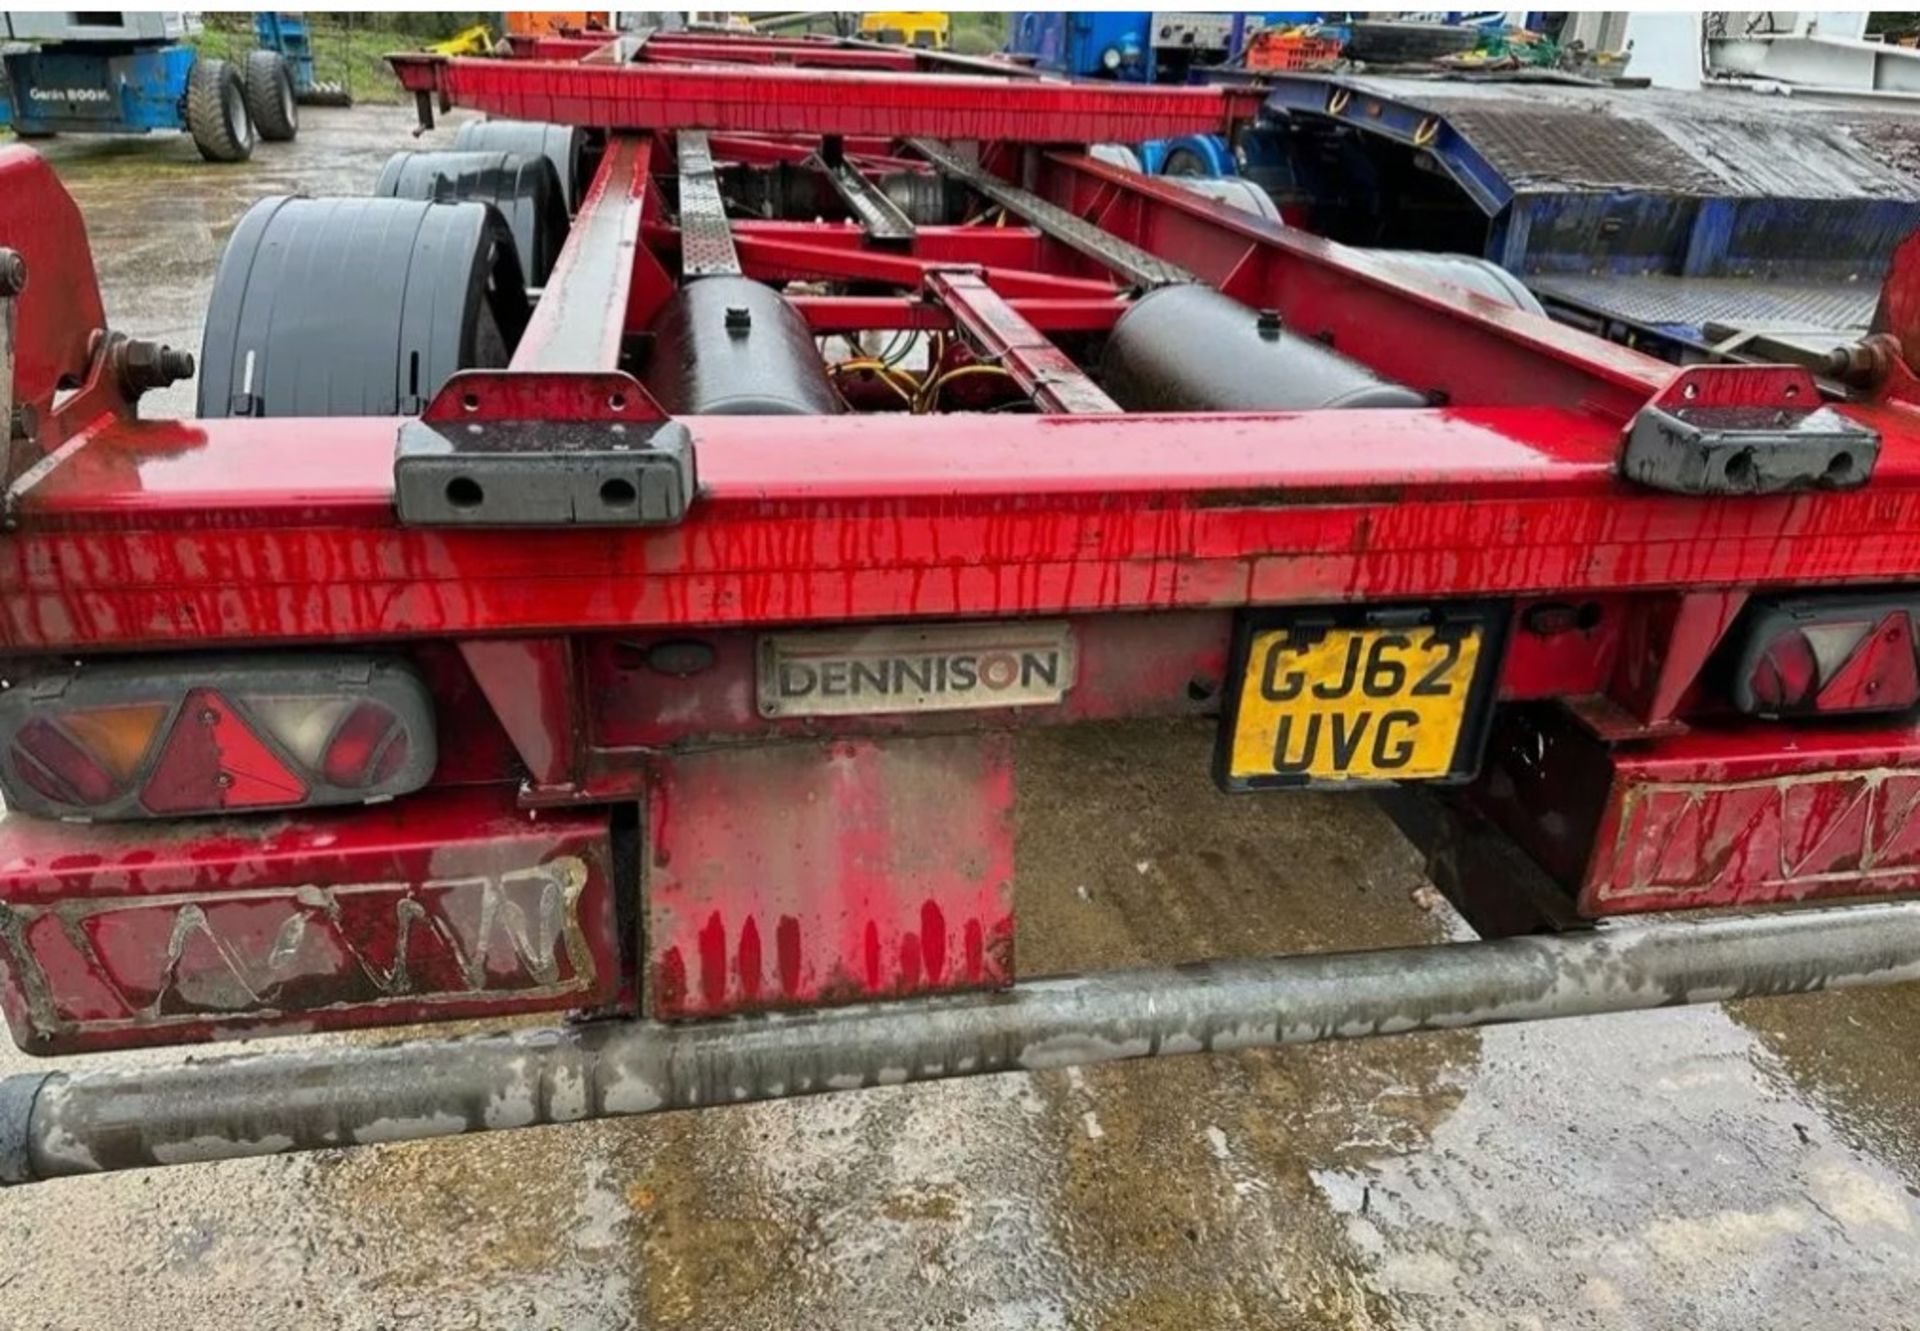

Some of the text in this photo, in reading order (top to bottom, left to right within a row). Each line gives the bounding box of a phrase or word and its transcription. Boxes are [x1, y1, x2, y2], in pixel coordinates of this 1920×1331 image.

[778, 652, 1058, 697] DENNISON
[1260, 635, 1460, 702] GJ62
[1272, 709, 1420, 772] UVG
